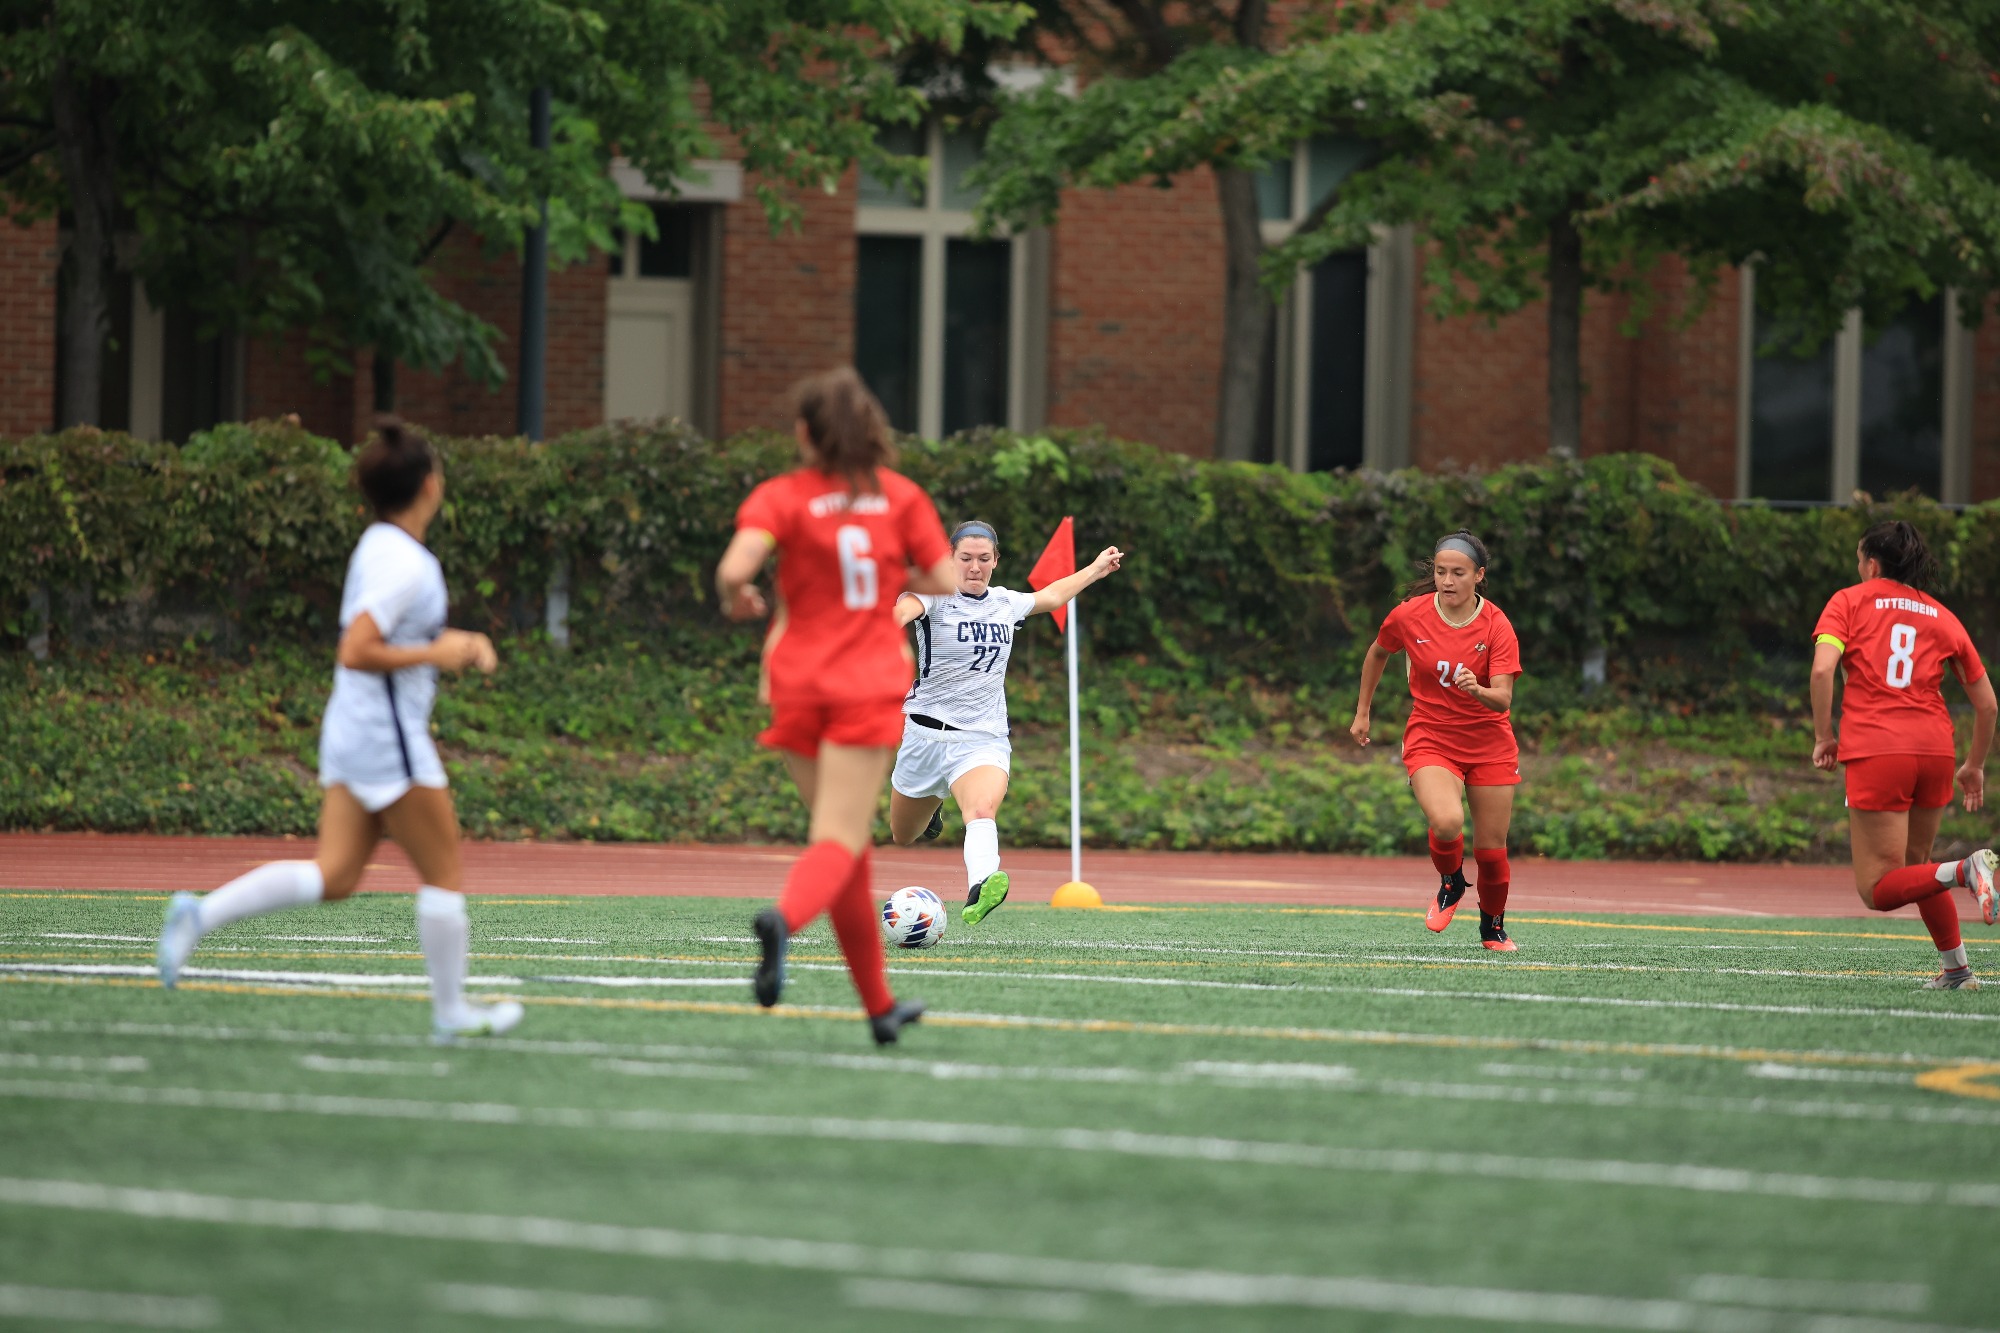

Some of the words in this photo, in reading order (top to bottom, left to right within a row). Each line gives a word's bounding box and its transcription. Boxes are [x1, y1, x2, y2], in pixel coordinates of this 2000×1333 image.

[837, 523, 879, 611] 6
[1875, 597, 1938, 618] OTTERBEIN
[957, 621, 1010, 644] CWRU
[969, 645, 1001, 673] 27
[1886, 623, 1917, 689] 8
